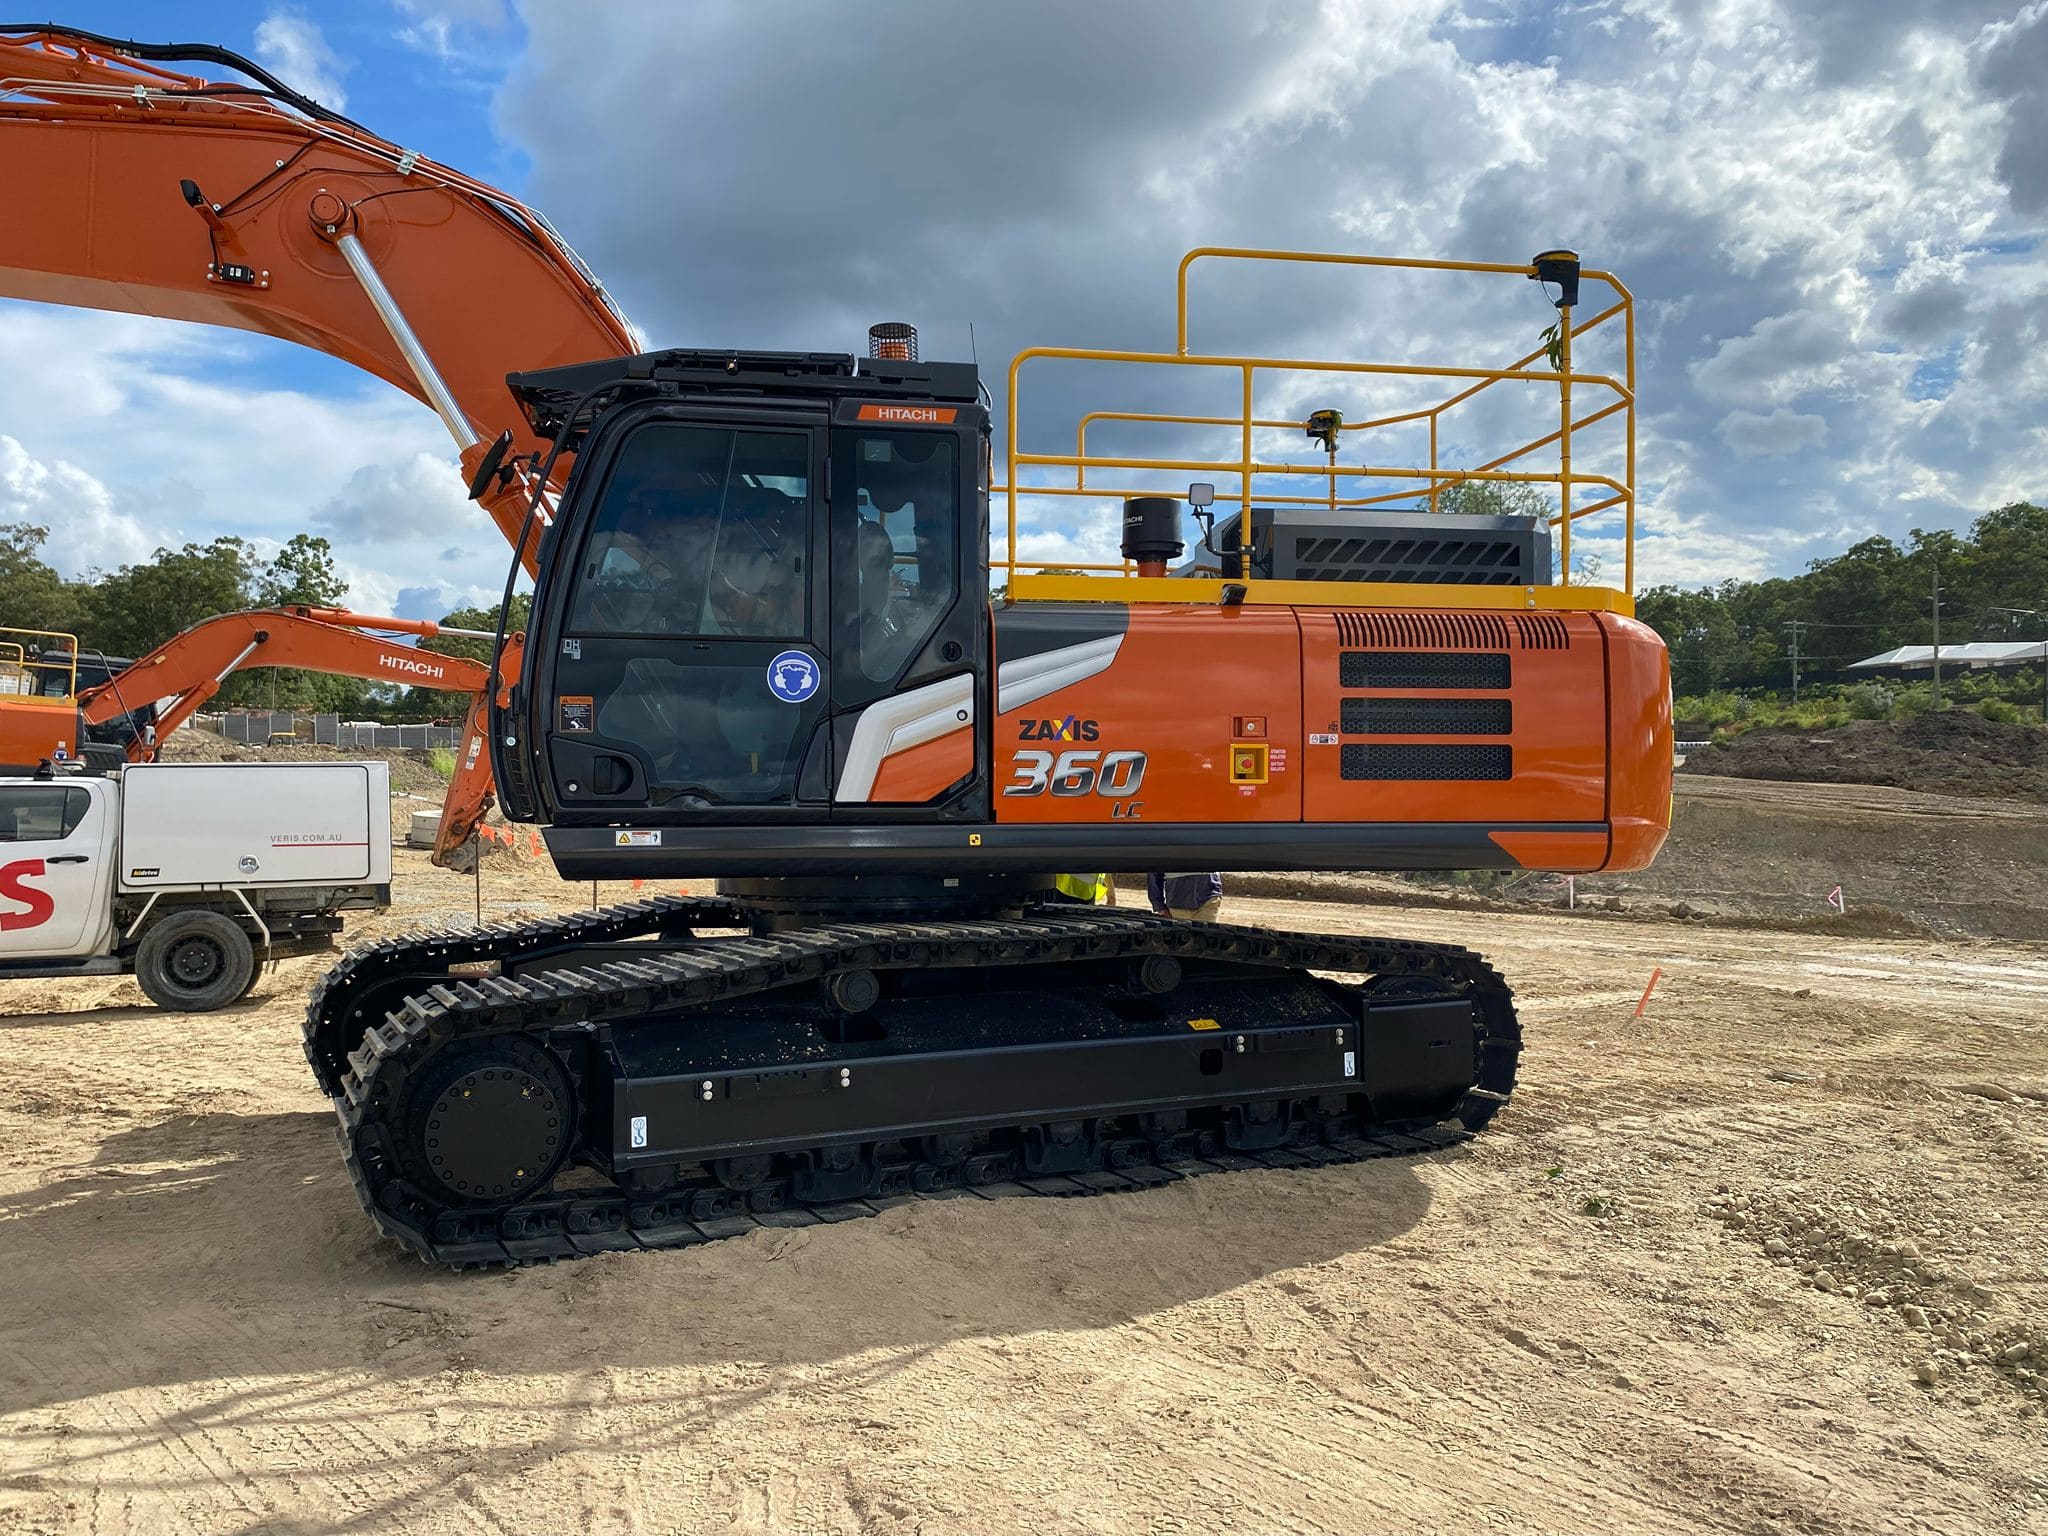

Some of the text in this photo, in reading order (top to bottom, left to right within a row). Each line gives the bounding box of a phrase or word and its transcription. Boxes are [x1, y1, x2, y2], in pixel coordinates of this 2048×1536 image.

[878, 408, 937, 421] HITACHI
[379, 654, 444, 679] HITACHI
[1018, 715, 1100, 742] ZAXIS
[1003, 750, 1148, 797] 360
[1112, 801, 1144, 819] LC
[270, 833, 343, 842] VERIS.COM.AU
